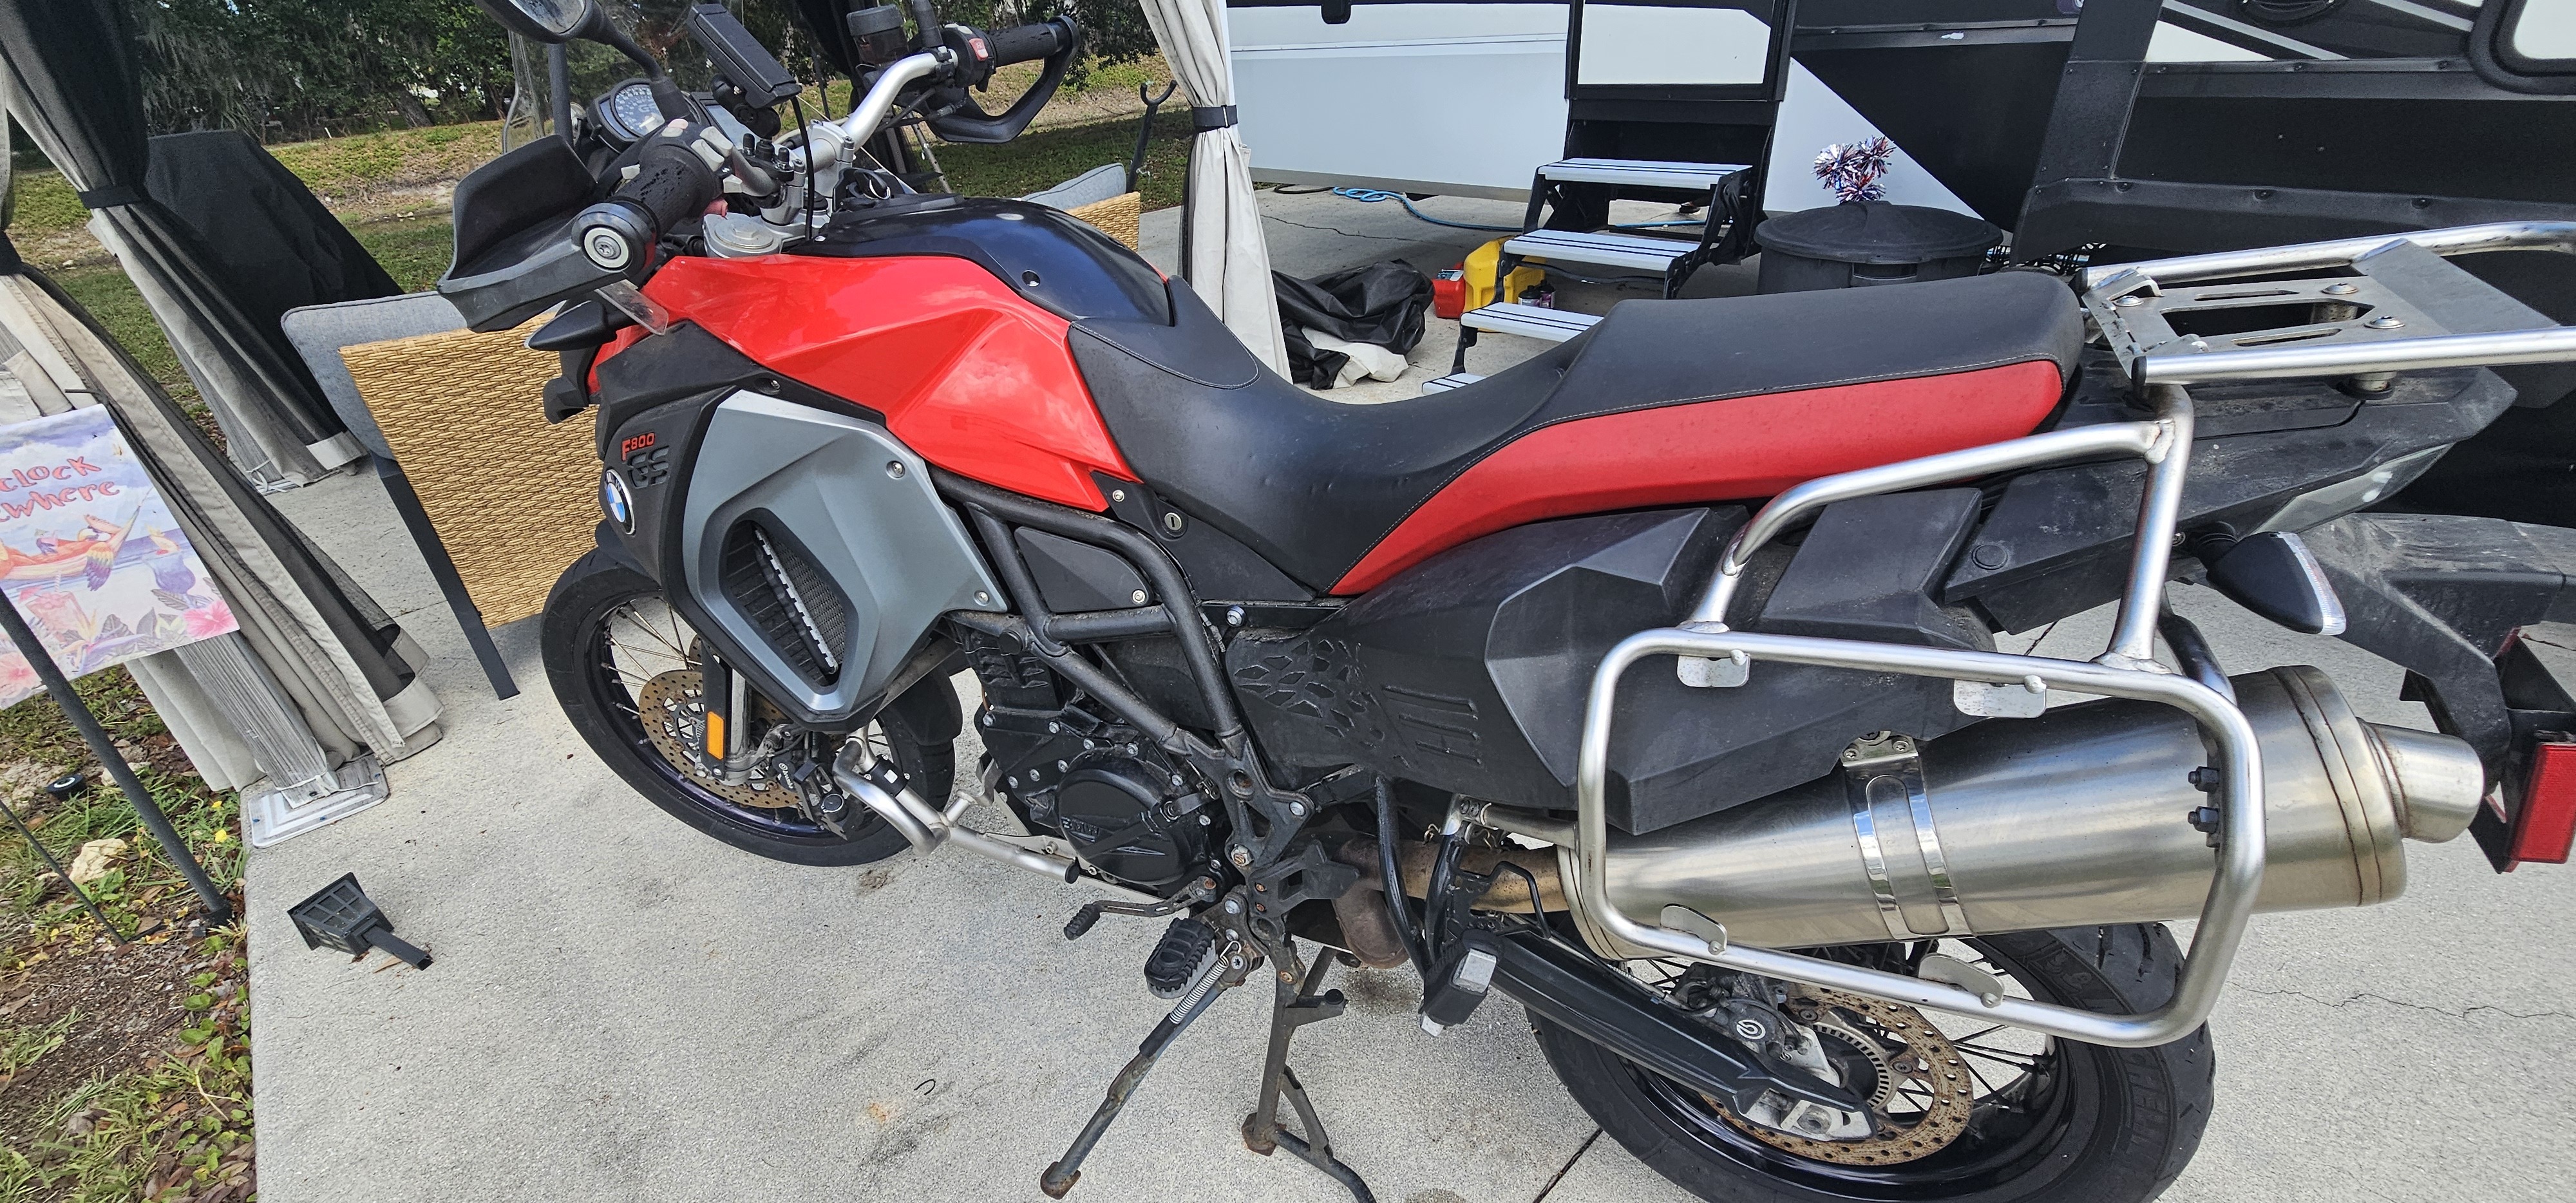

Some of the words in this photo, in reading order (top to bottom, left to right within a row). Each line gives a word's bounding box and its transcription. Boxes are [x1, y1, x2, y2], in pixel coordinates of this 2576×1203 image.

[621, 432, 655, 461] F800
[628, 446, 669, 489] GS
[0, 481, 120, 522] where
